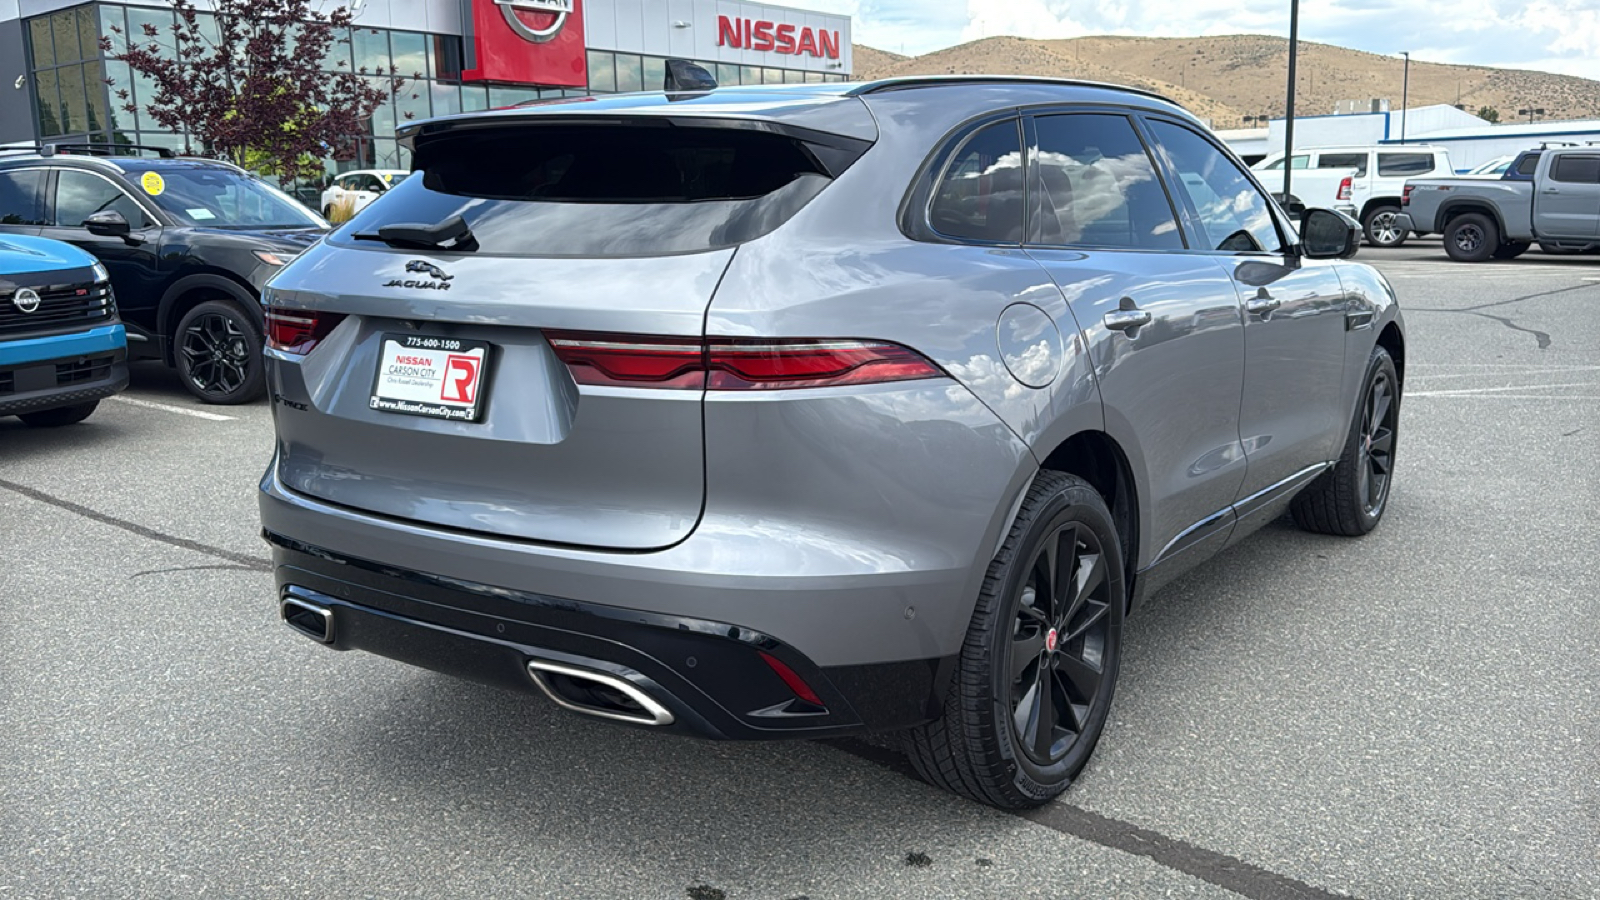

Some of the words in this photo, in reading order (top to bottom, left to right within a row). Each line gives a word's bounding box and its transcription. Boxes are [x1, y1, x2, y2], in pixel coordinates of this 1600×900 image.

[716, 14, 840, 60] NISSAN
[382, 280, 451, 291] JAGUAR
[406, 337, 460, 350] 775-600-1500
[395, 355, 433, 367] NISSAN
[388, 364, 420, 377] CARSON
[420, 368, 437, 379] CITY
[379, 400, 466, 419] www.NissanCarsonCity.com
